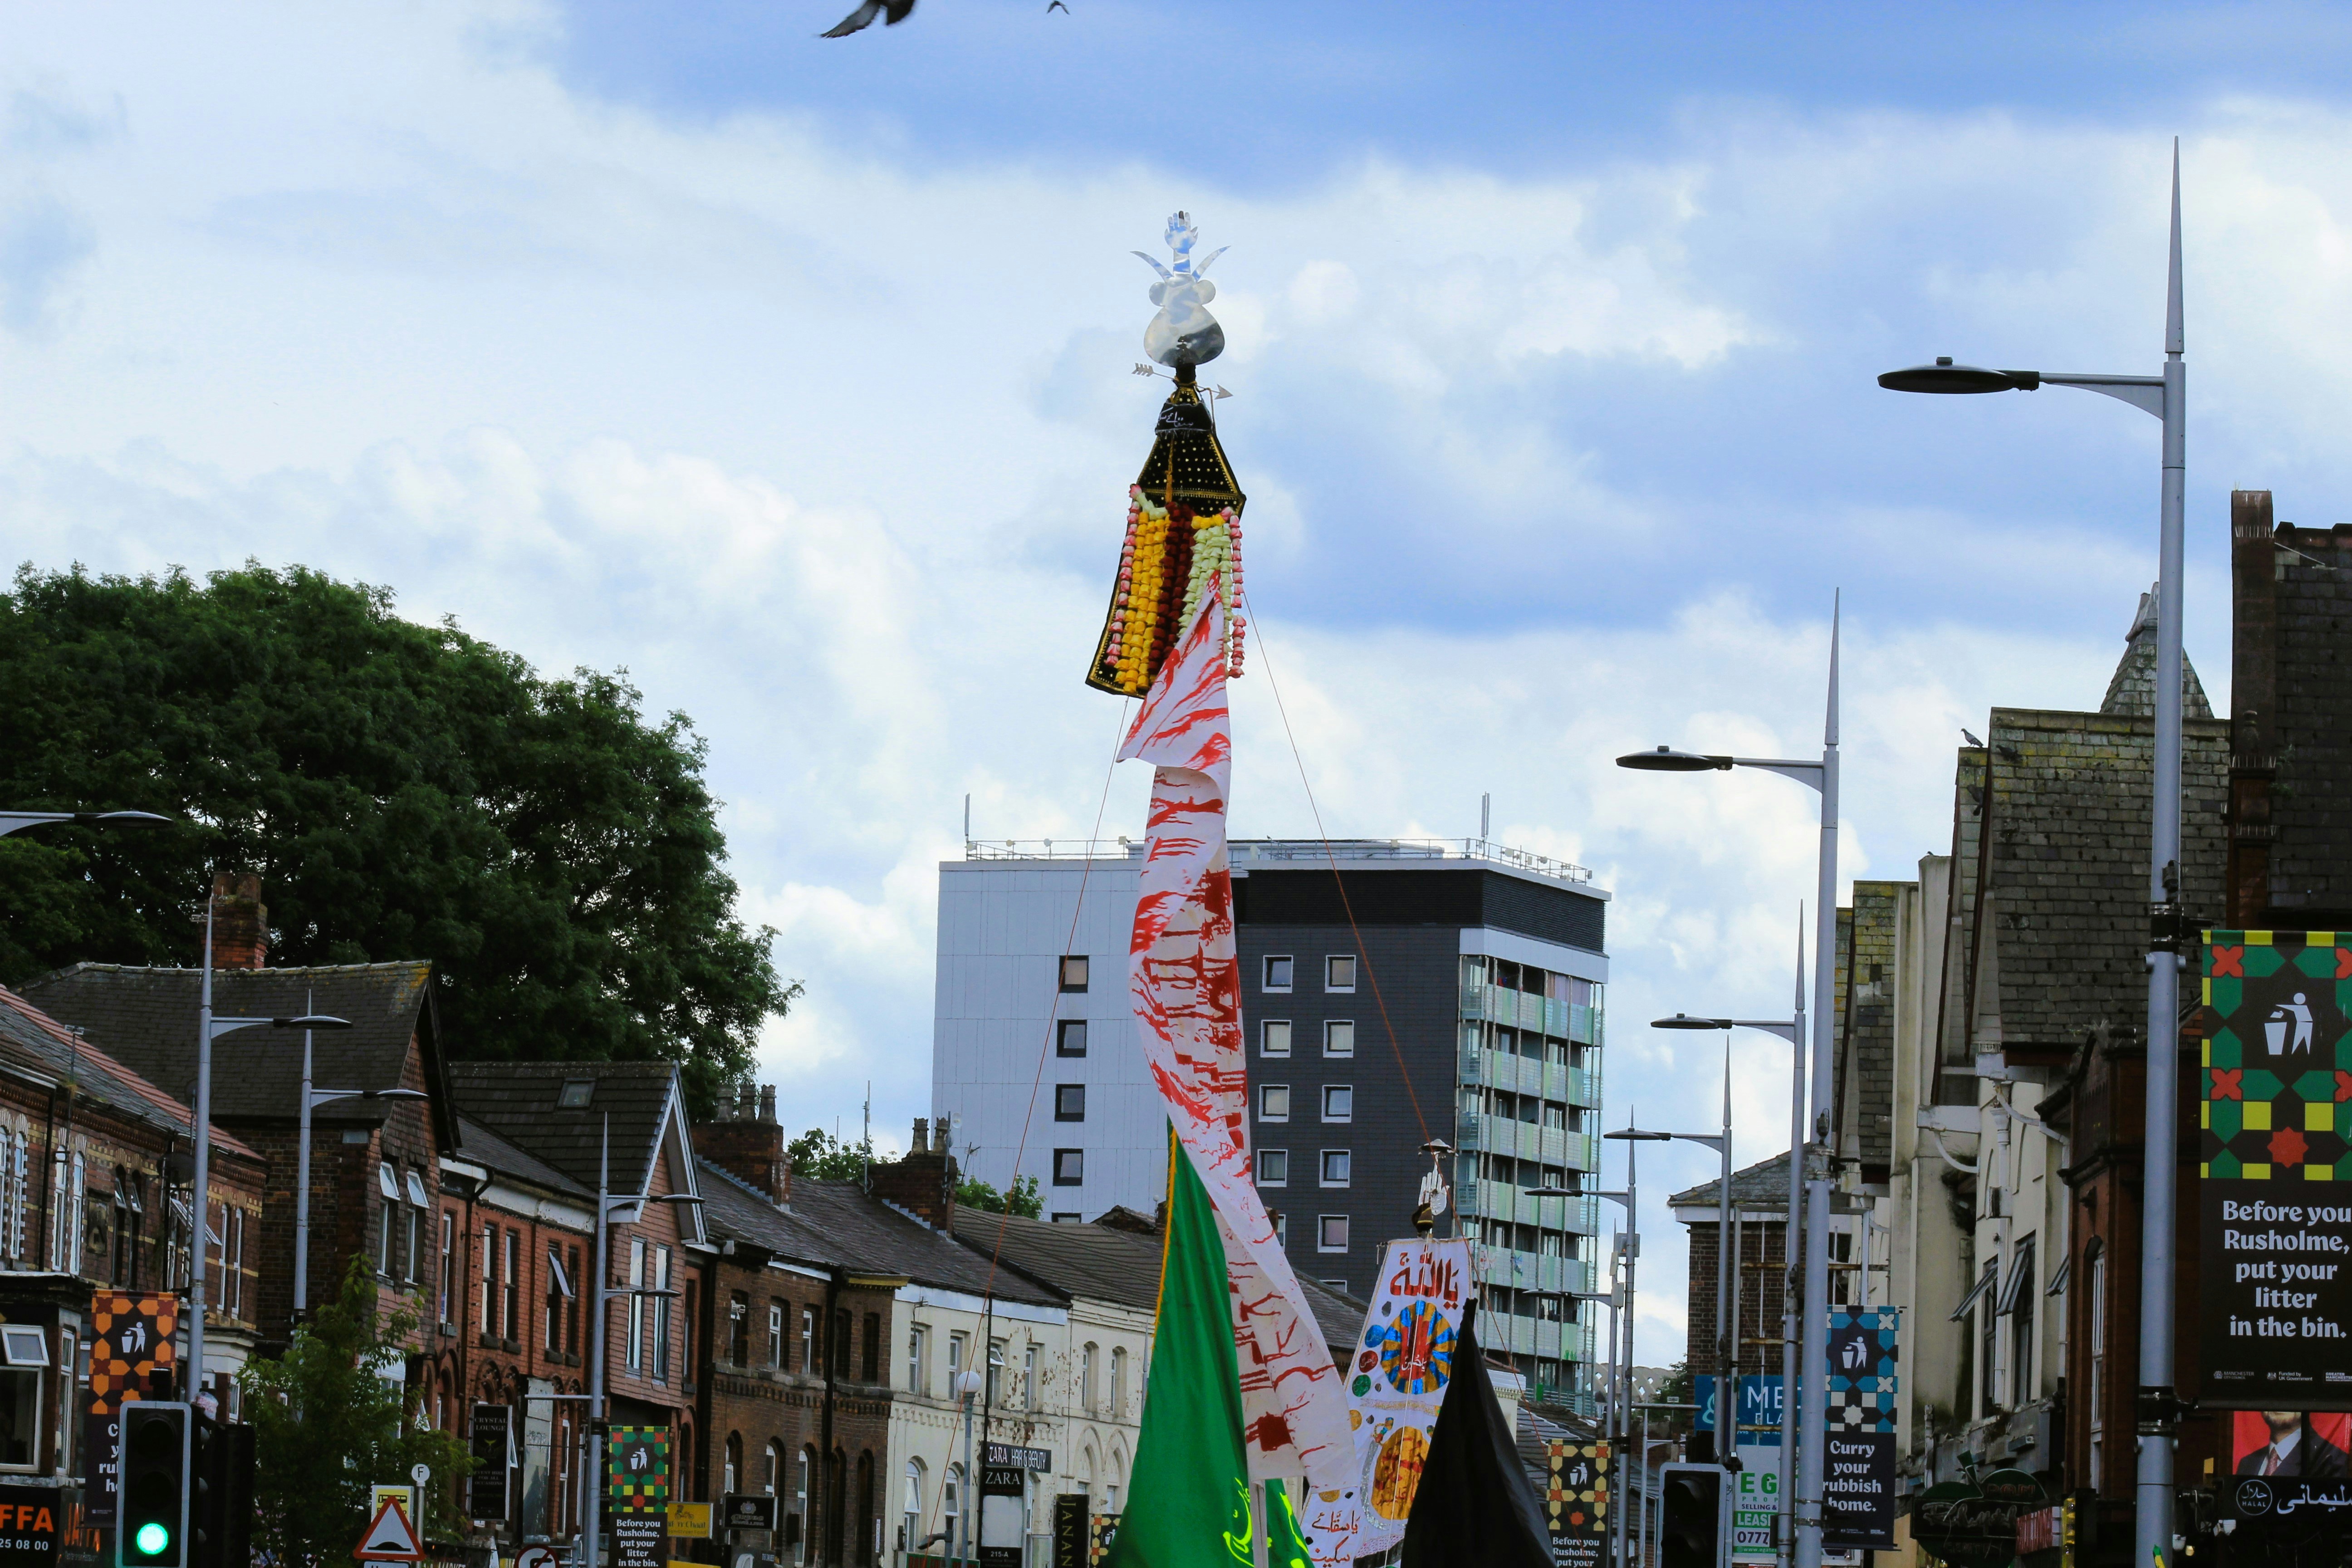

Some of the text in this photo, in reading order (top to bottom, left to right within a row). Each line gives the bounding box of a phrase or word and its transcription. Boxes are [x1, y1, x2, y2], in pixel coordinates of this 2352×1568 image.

[2223, 1200, 2351, 1226] Before you
[2225, 1230, 2350, 1254] Rusholme,
[2236, 1261, 2337, 1284] put your
[2256, 1287, 2317, 1308] litter
[2230, 1315, 2347, 1338] in the bin.
[1830, 1441, 1875, 1458] Curry
[989, 1446, 1008, 1463] ZARA
[1011, 1449, 1023, 1466] HAIR
[1029, 1450, 1046, 1469] BEAUTY
[418, 1467, 424, 1477] F
[1833, 1463, 1870, 1475] your
[985, 1472, 1020, 1485] ZARA
[1823, 1478, 1882, 1493] rubbish
[1828, 1497, 1877, 1512] home.
[617, 1529, 660, 1538] Rusholme,
[1060, 1502, 1076, 1567] JANAN
[1553, 1537, 1581, 1545] Before
[16, 1539, 29, 1549] 08
[35, 1541, 49, 1551] 00
[1553, 1548, 1598, 1557] Rusholme,
[1557, 1559, 1572, 1567] put
